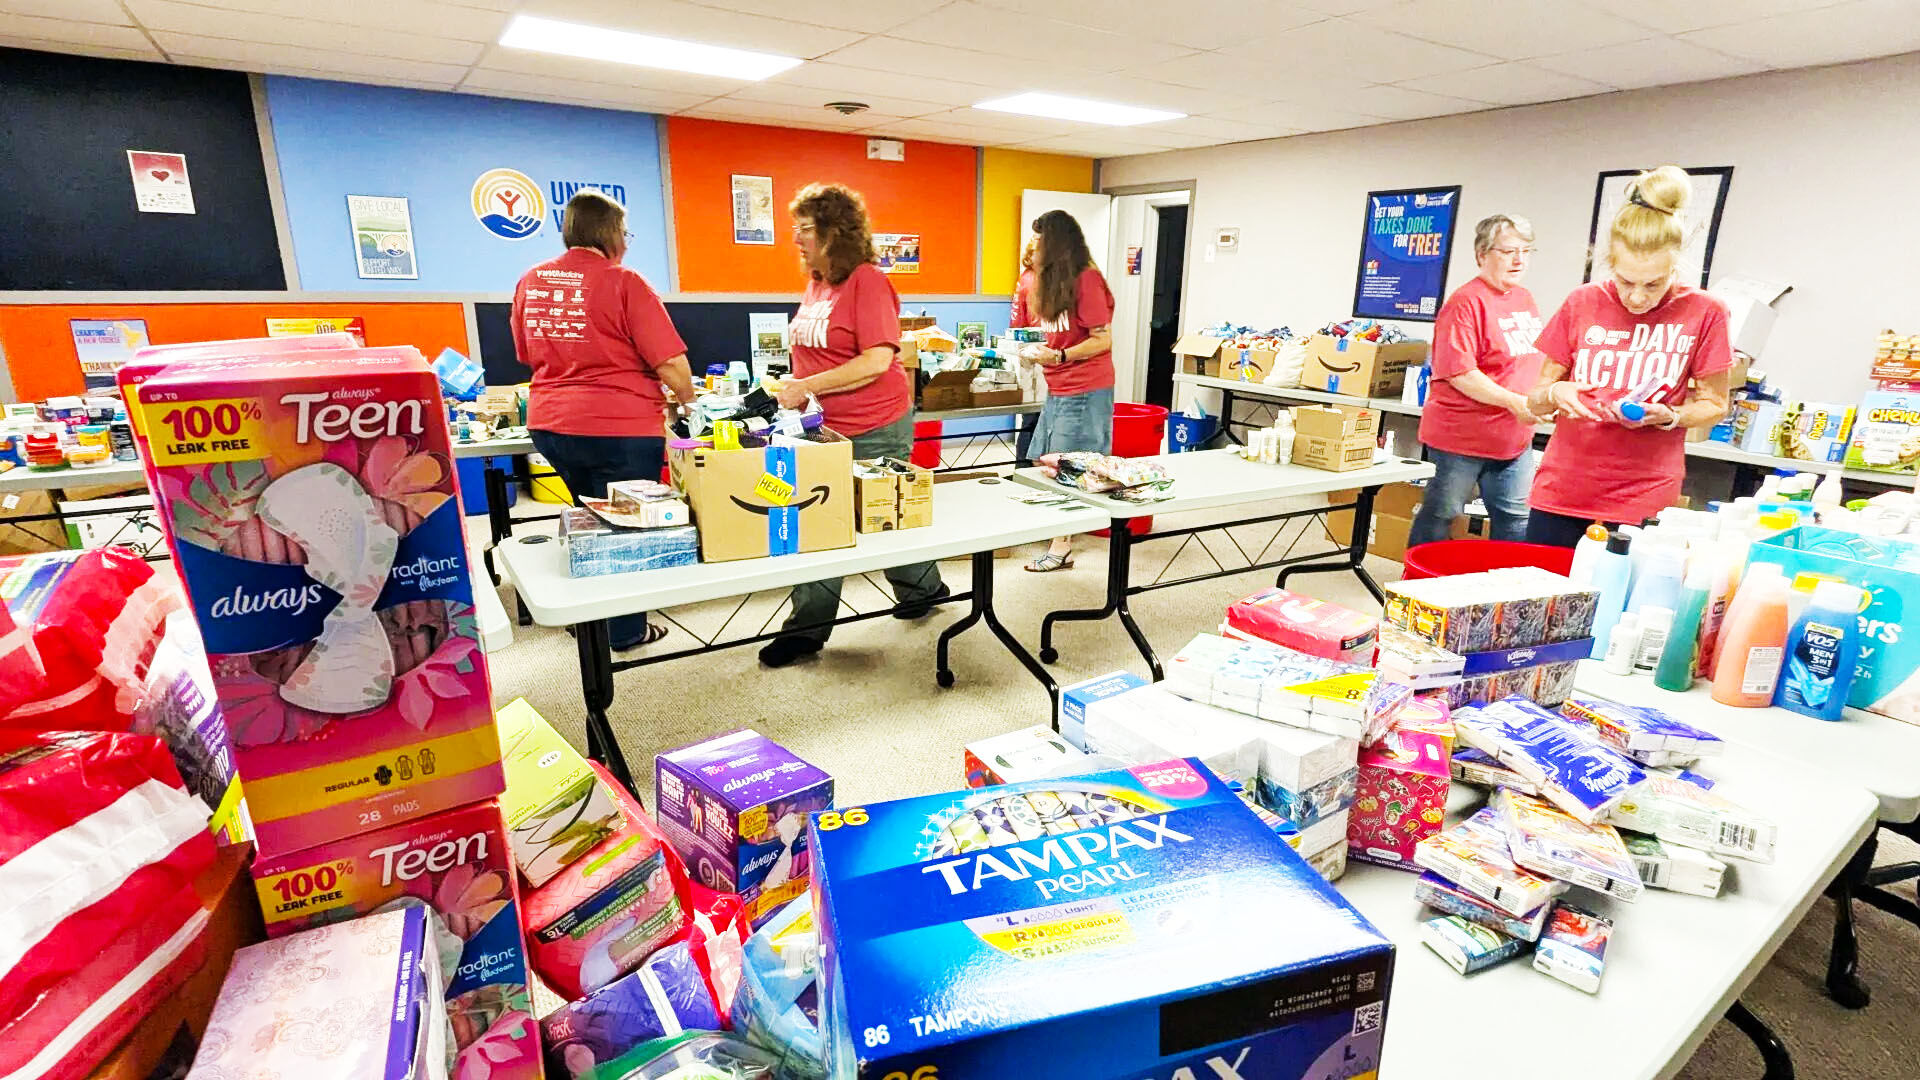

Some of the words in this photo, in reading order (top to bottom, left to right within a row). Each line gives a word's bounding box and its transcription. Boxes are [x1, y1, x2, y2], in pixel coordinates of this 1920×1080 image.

[1375, 207, 1386, 218] GET
[1387, 206, 1404, 217] YOUR
[1374, 218, 1404, 235] TAXES
[1406, 216, 1435, 233] DONE
[1393, 234, 1408, 248] FOR
[1408, 233, 1442, 256] FREE
[1629, 324, 1684, 352] DAY
[1676, 335, 1696, 353] OF
[1574, 349, 1689, 390] ACTION
[162, 401, 262, 441] 100%
[167, 443, 206, 456] LEAK
[211, 438, 251, 451] FREE
[760, 479, 791, 500] HEAVY
[392, 555, 460, 579] radiant
[211, 583, 323, 619] always
[1806, 633, 1838, 648] VO5
[1809, 647, 1835, 660] MEN
[324, 776, 371, 794] REGULAR
[723, 766, 776, 793] always
[358, 810, 382, 826] 28
[392, 800, 420, 816] PADS
[816, 807, 870, 832] 86
[742, 849, 779, 876] always
[921, 815, 1195, 896] TAMPAX
[272, 861, 354, 903] 100%
[275, 899, 309, 914] LEAK
[311, 890, 344, 905] FREE
[1064, 904, 1095, 915] LIGHT
[545, 925, 562, 941] 16
[458, 947, 516, 977] radiant
[863, 1023, 891, 1048] 86
